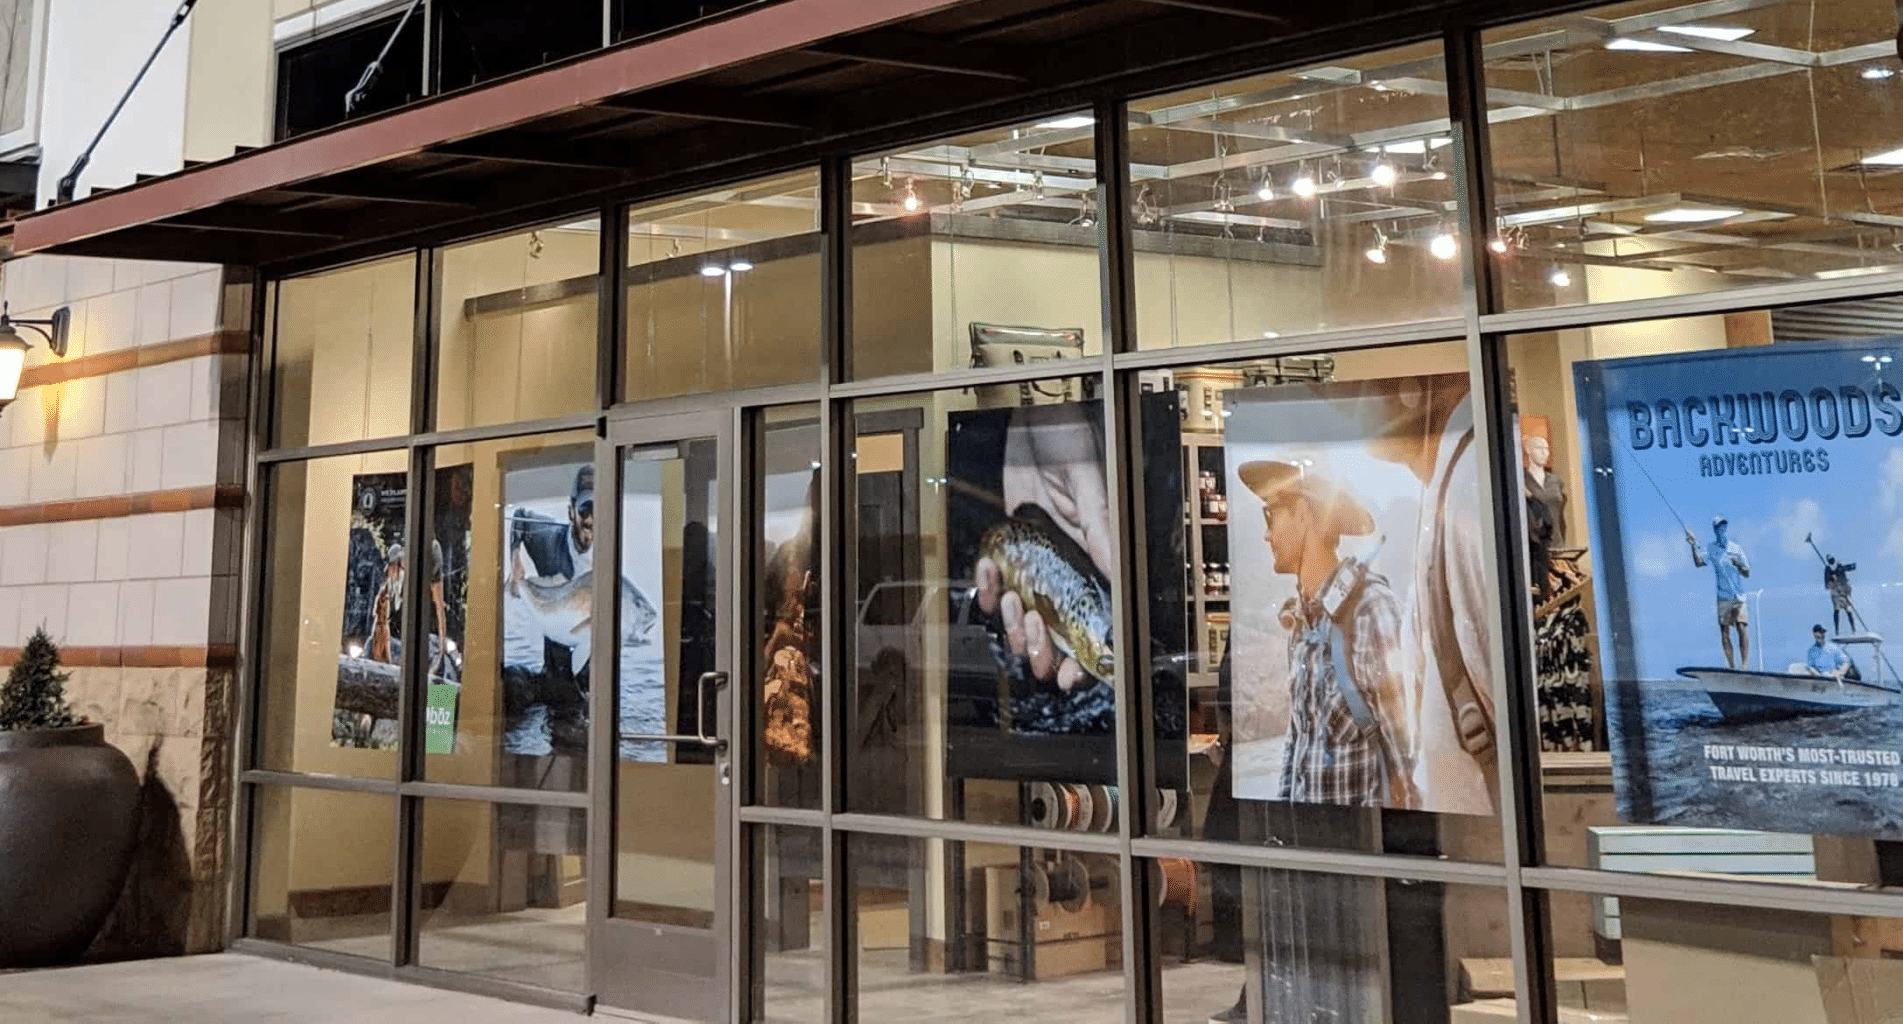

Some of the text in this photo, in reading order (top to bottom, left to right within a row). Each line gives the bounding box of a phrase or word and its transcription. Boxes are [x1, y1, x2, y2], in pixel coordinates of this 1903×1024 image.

[1626, 382, 1903, 451] BACKWOODS
[1699, 447, 1831, 477] ADVENTURES
[1703, 744, 1900, 766] FORT WORTH'S MOST-TRUSTED
[1709, 765, 1758, 782] TRAVEL
[1759, 767, 1817, 784] EXPERTS
[1819, 770, 1861, 787] SINCE
